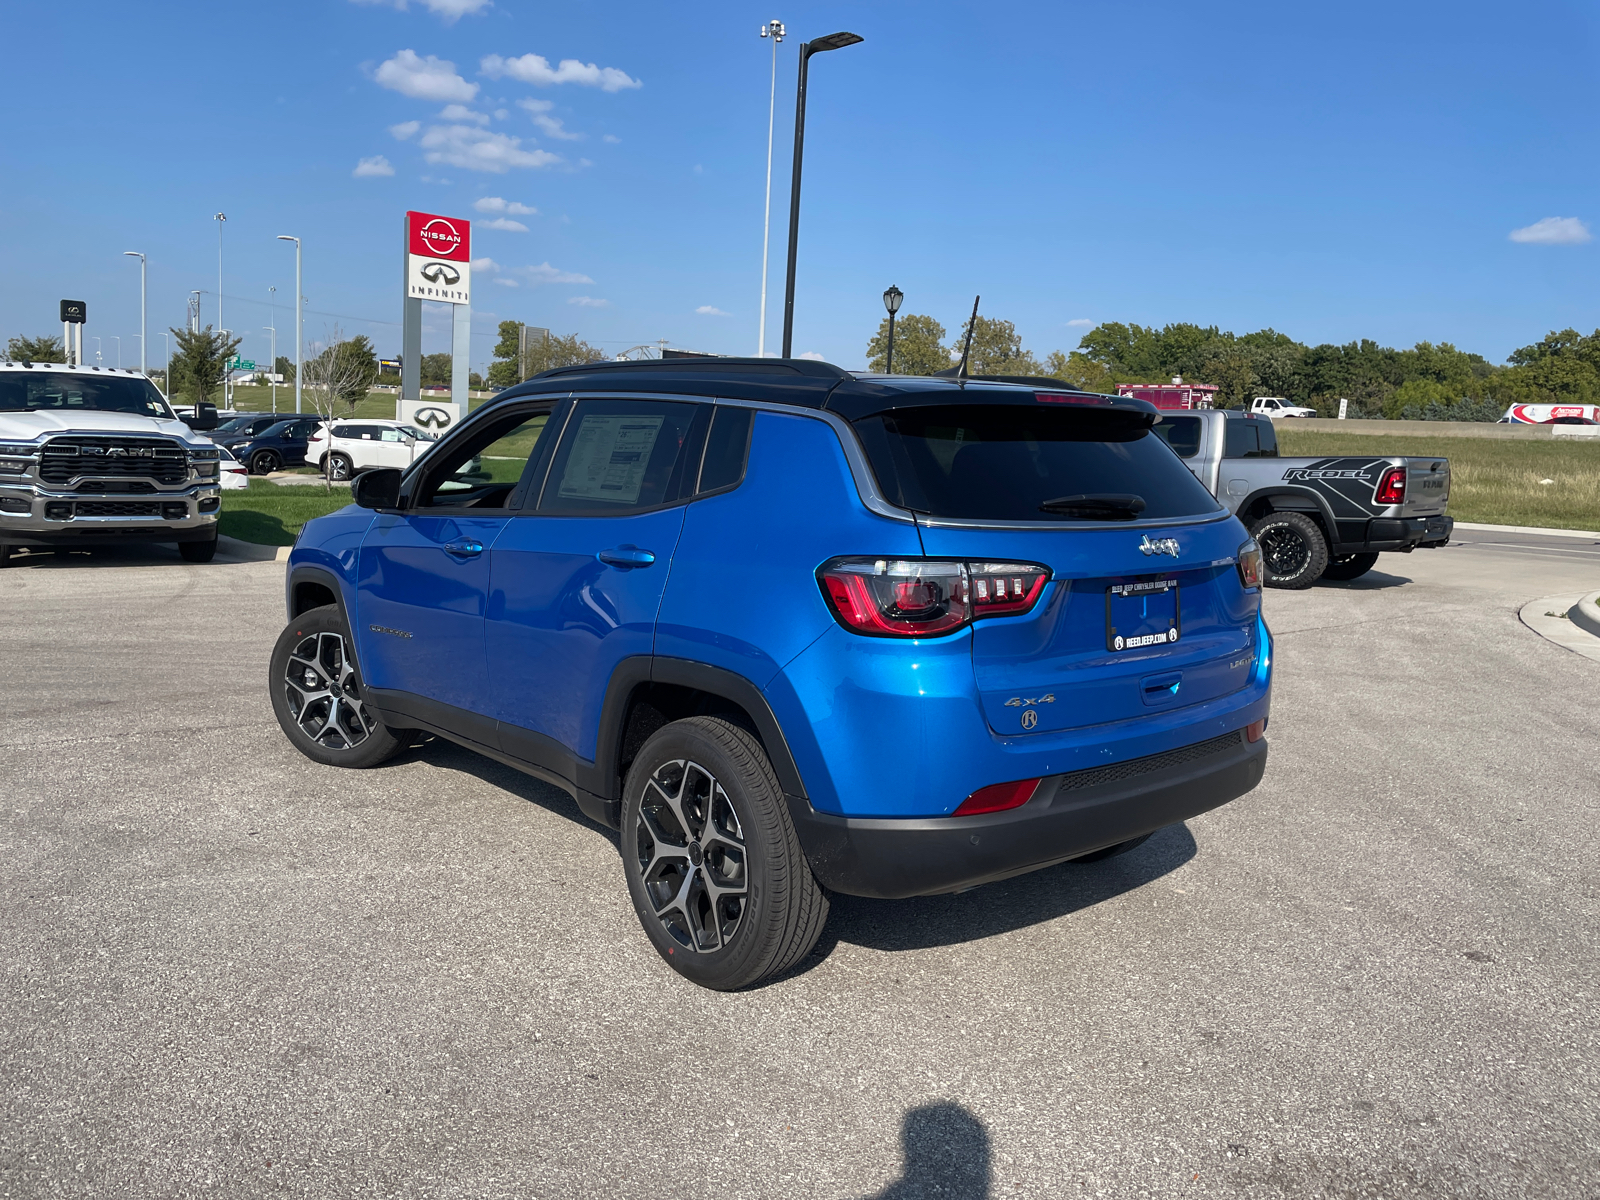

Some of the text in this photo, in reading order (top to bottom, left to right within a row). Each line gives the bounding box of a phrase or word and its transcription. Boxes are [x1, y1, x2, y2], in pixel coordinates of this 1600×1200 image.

[420, 230, 461, 243] NISSAN
[412, 285, 468, 301] INFINITI
[81, 446, 152, 457] RAM
[1281, 468, 1372, 481] REBEL
[1423, 480, 1444, 489] RAM
[1138, 534, 1181, 559] Jeep
[1124, 584, 1133, 592] JEEP
[1134, 582, 1154, 591] CHRYSLER
[1126, 633, 1167, 648] REEDJEEP.COM
[1004, 693, 1056, 707] 4x4
